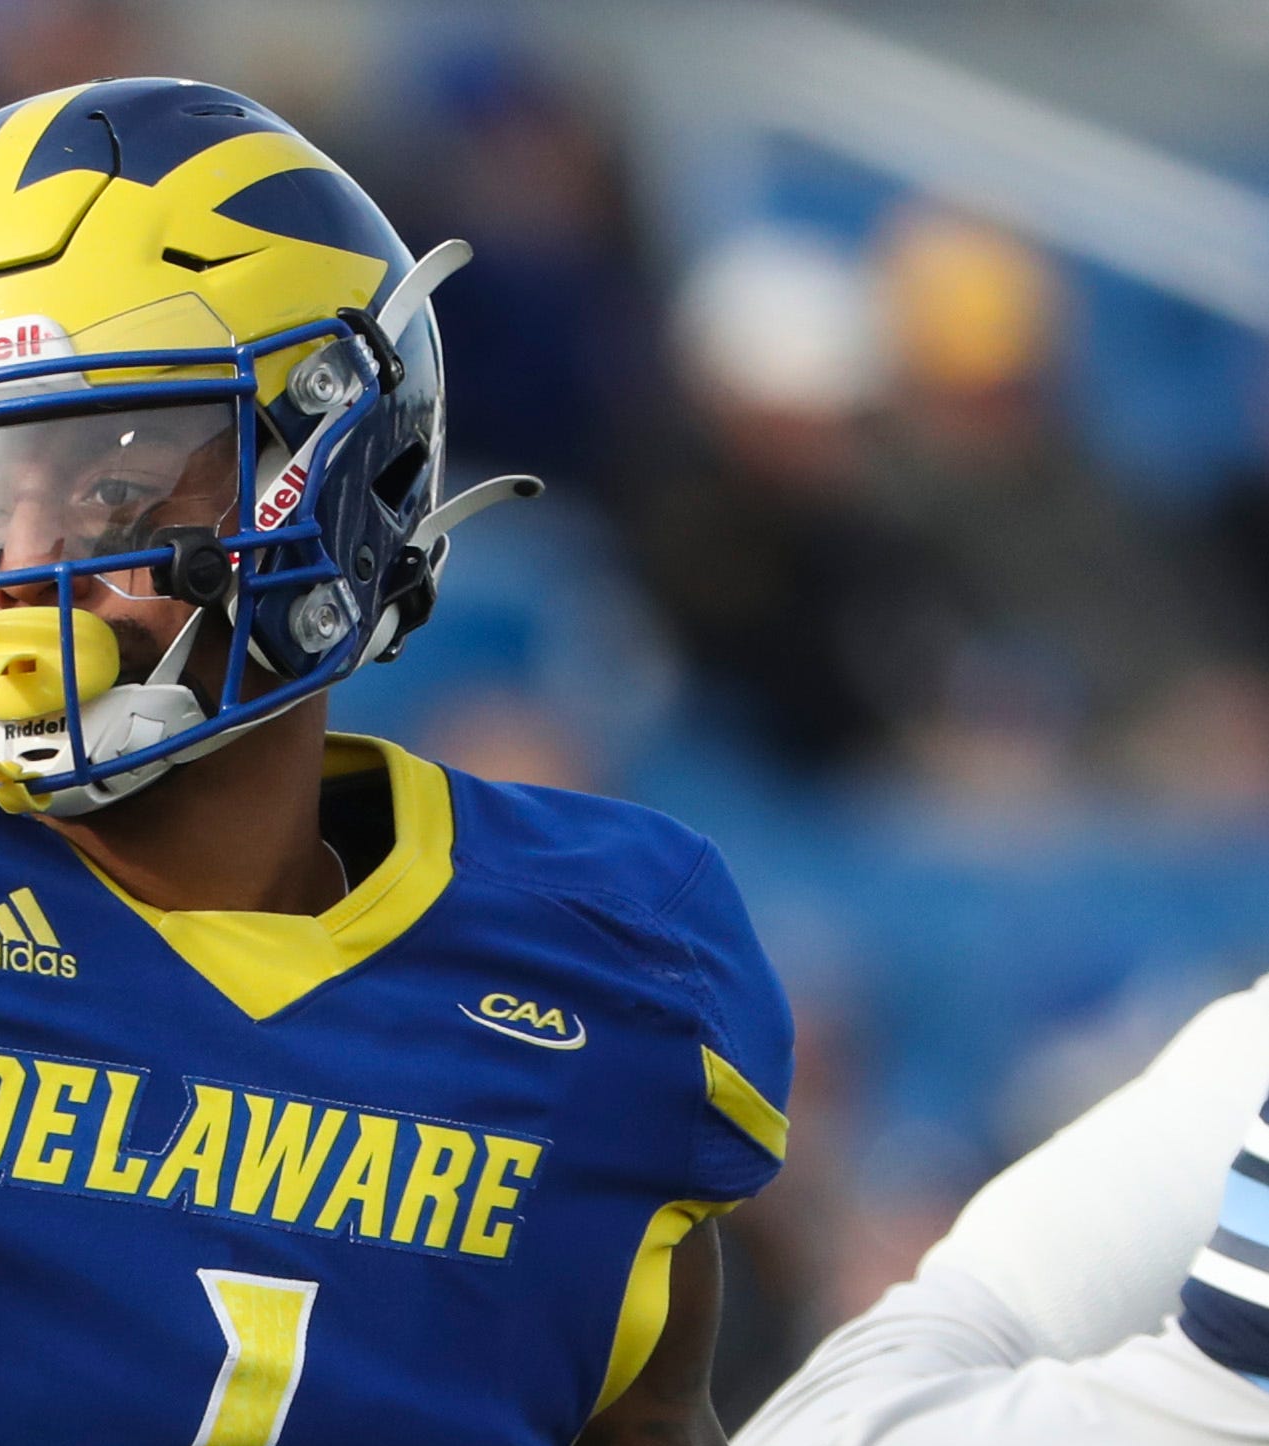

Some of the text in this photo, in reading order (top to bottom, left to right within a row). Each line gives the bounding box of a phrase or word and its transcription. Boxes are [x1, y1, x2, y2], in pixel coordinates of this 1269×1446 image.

[254, 463, 309, 532] dell
[4, 717, 67, 739] Riddel
[479, 991, 567, 1036] CAA
